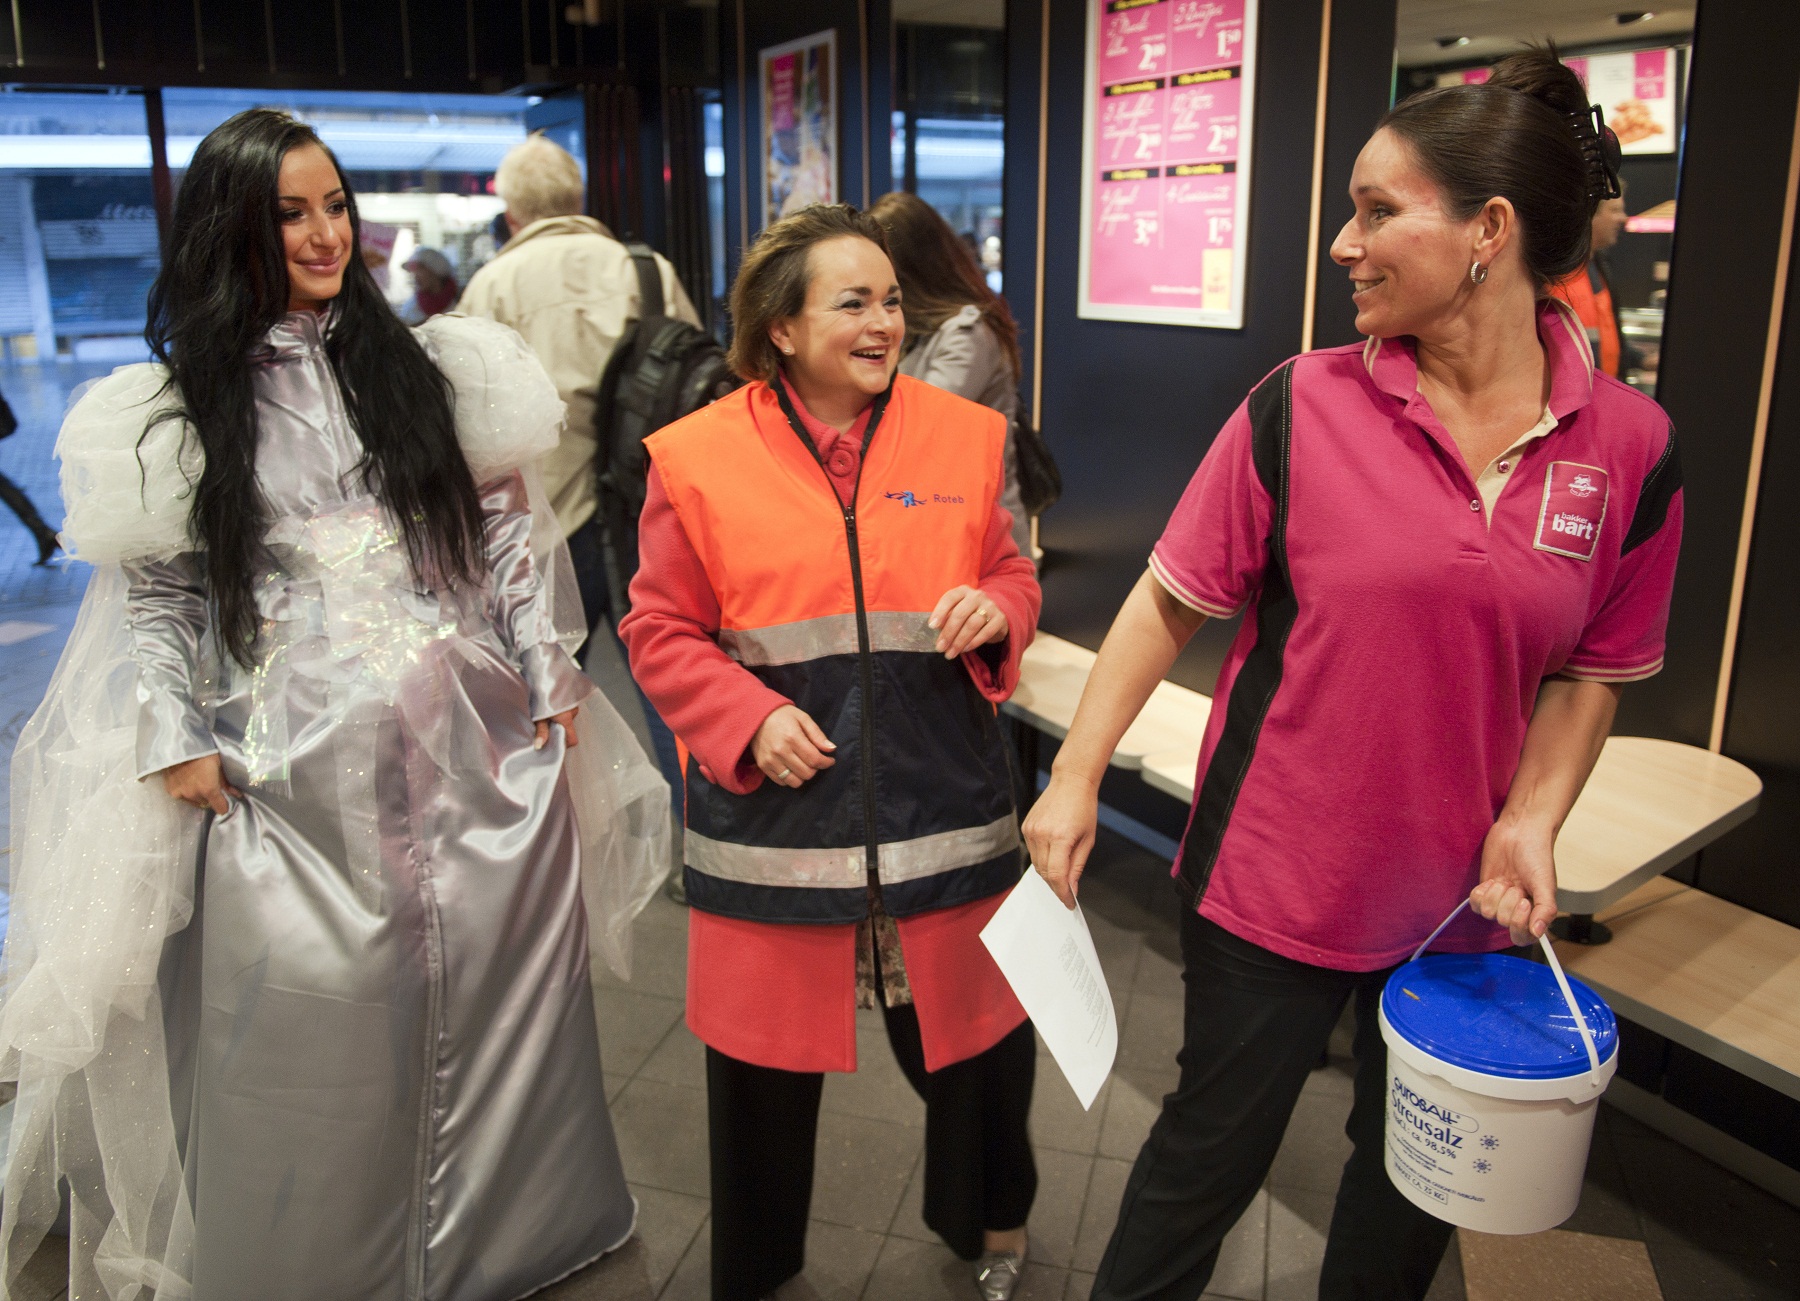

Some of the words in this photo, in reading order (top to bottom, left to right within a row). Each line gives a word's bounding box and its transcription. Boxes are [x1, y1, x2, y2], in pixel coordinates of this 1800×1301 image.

[933, 493, 965, 504] Roteb
[1552, 513, 1593, 540] bart
[1561, 512, 1588, 524] bakker
[1392, 1089, 1463, 1149] Streusalz
